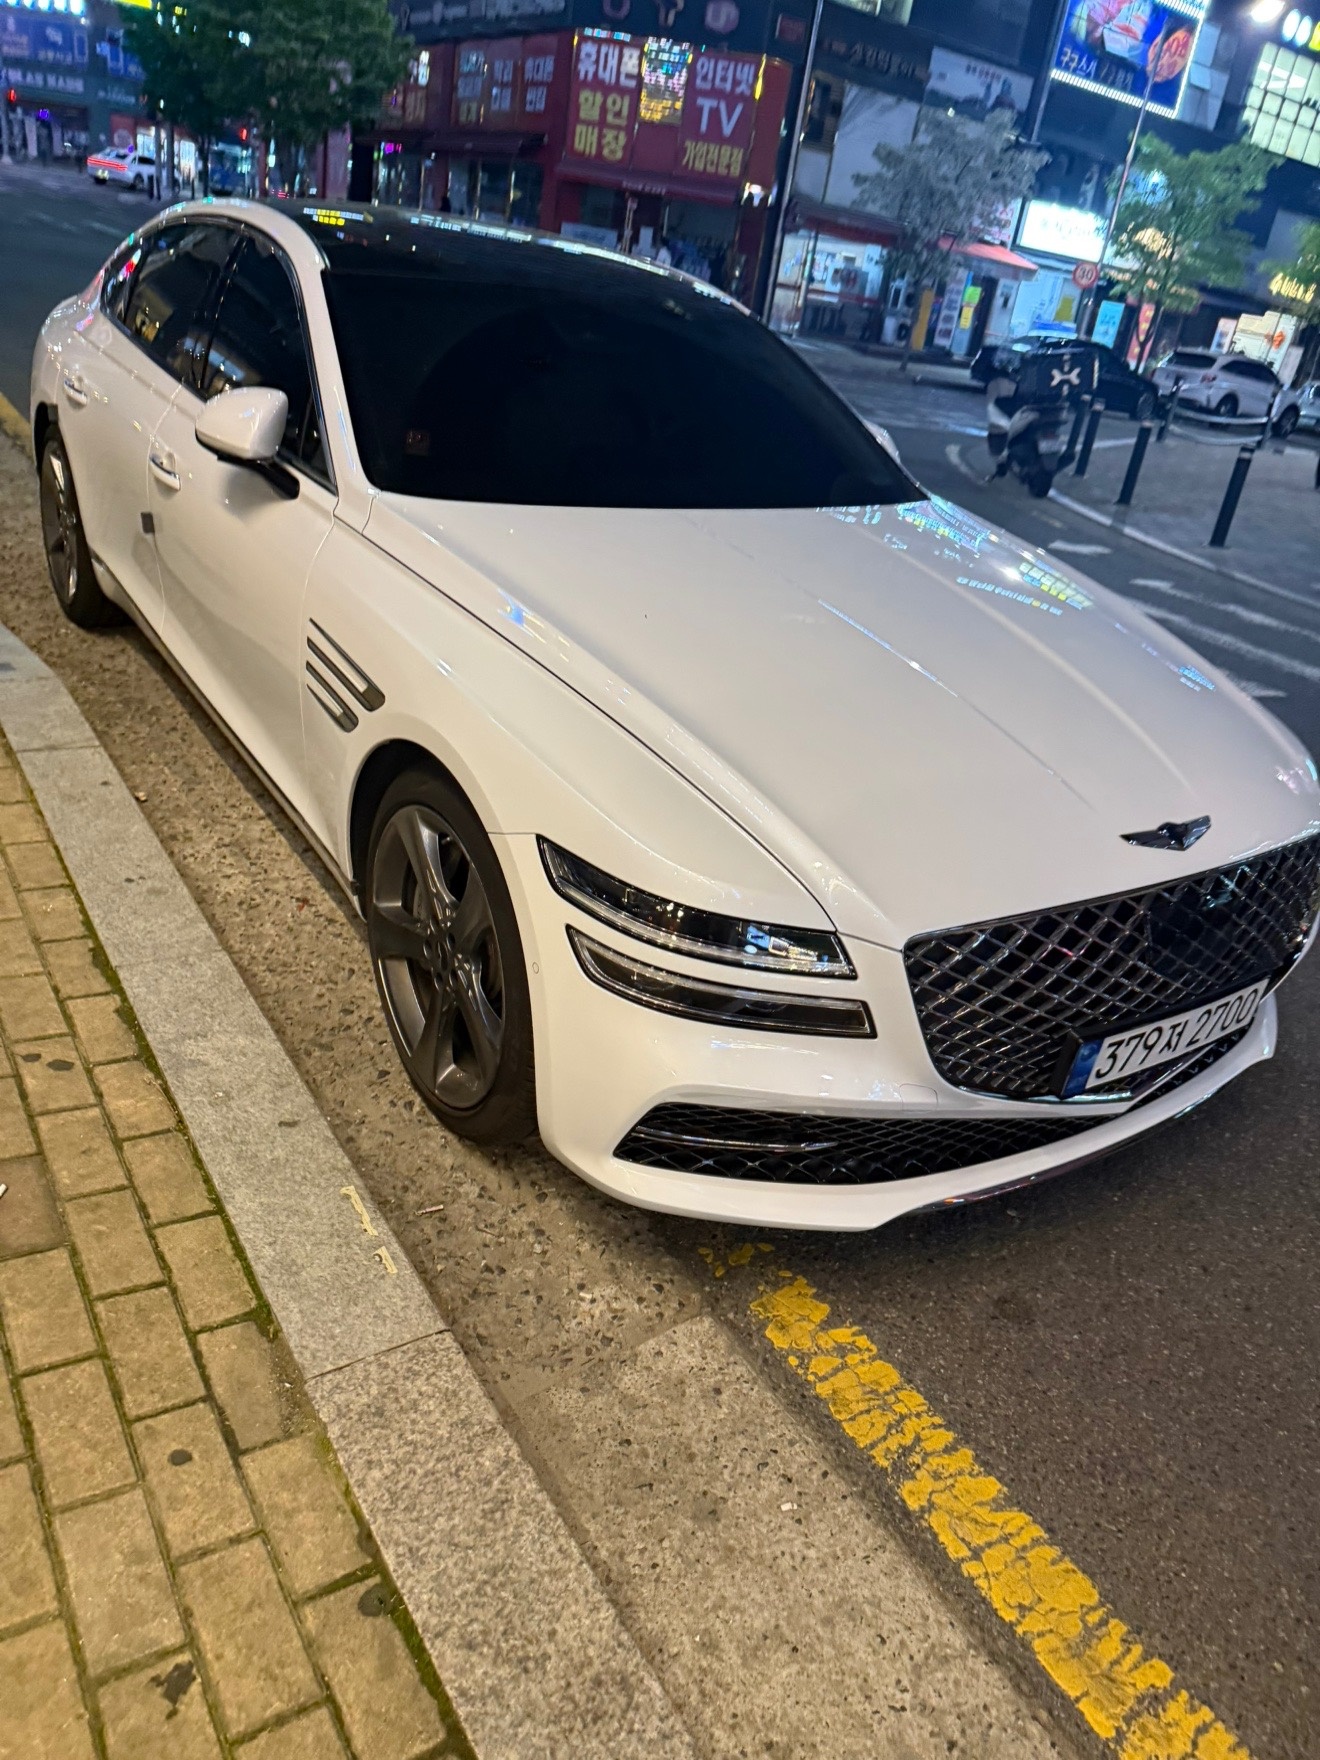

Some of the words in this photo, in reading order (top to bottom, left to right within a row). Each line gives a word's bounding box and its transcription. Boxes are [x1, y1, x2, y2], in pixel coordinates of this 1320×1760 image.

[578, 41, 641, 89] 휴대폰
[695, 56, 756, 96] 인터넷
[578, 89, 630, 126] 할인
[696, 97, 744, 138] TV
[573, 123, 627, 162] 매장
[1095, 1018, 1187, 1079] 379저
[1187, 988, 1259, 1045] 2700
